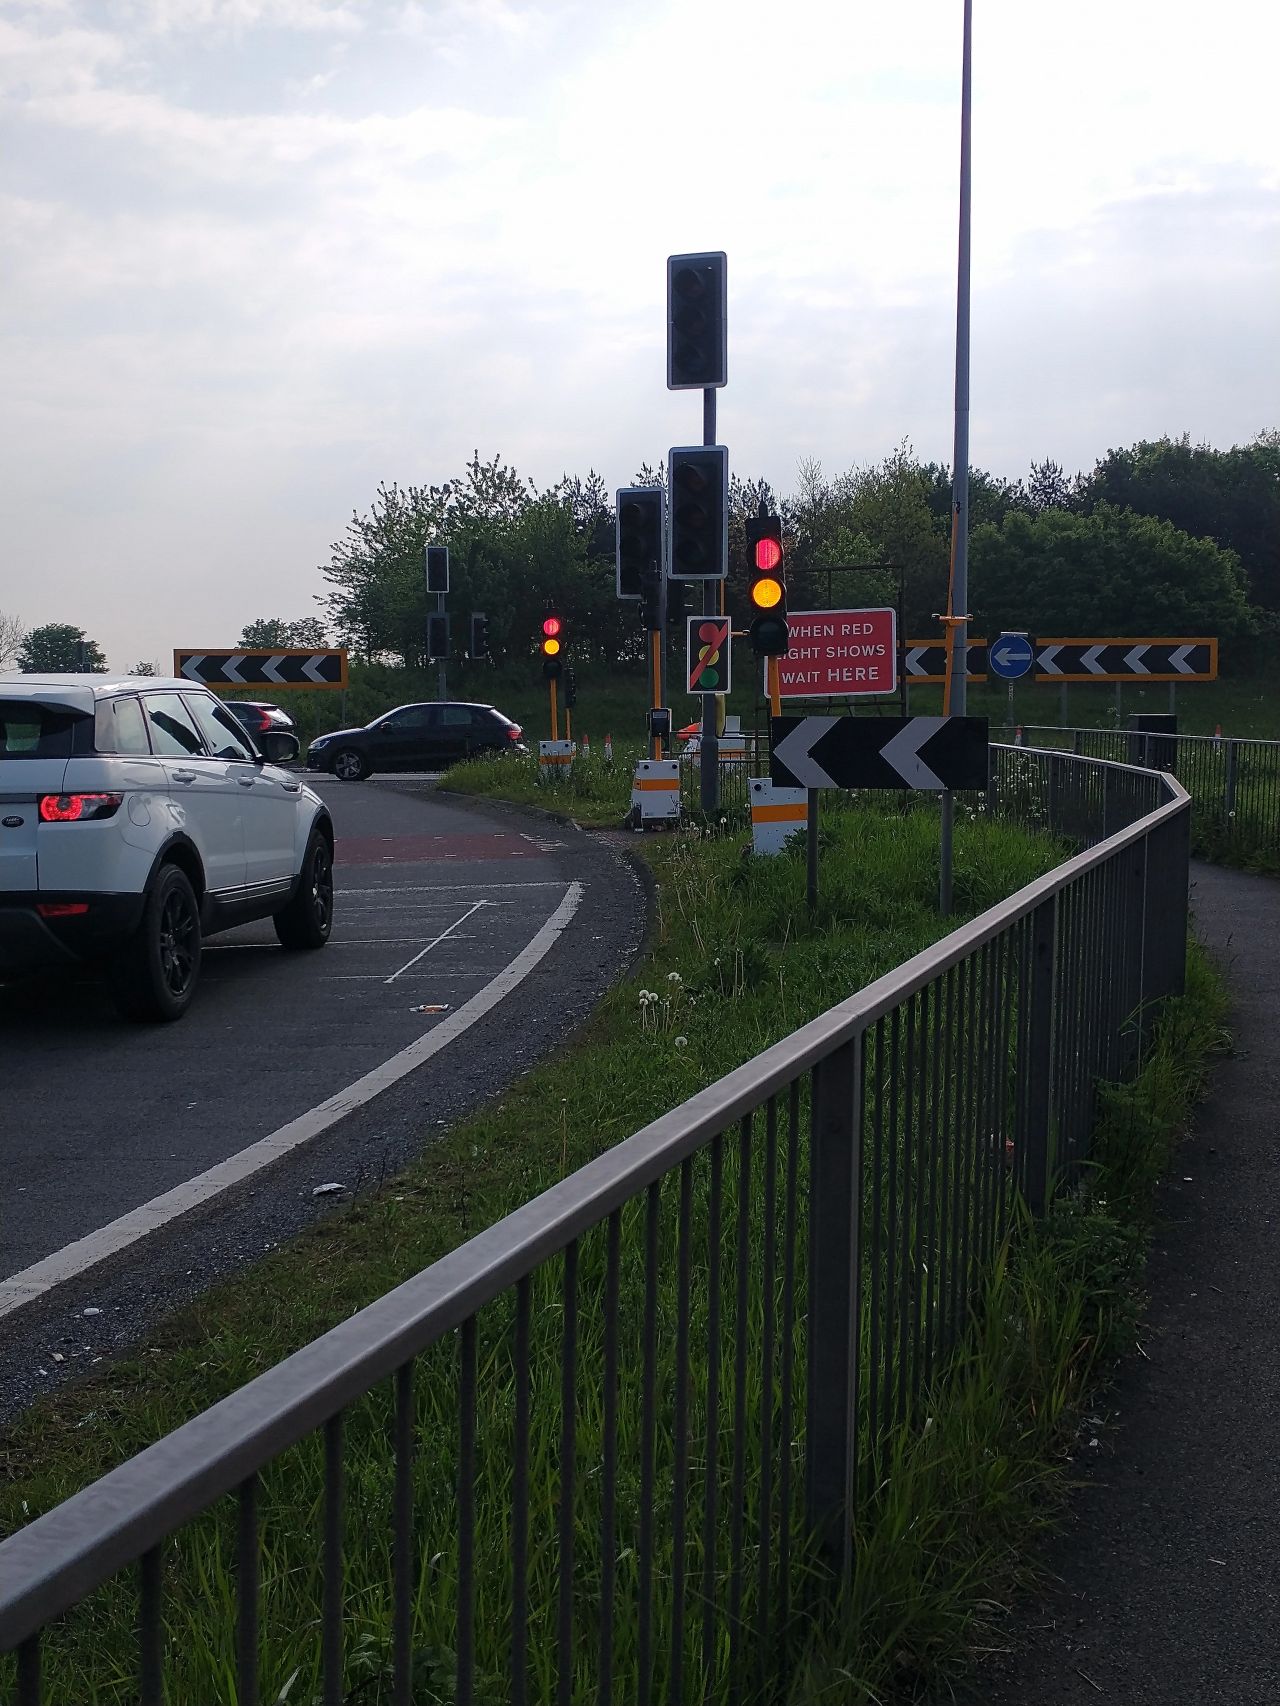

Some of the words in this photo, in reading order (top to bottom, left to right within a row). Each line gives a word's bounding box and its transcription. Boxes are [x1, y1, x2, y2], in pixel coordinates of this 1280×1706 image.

[788, 625, 835, 638] WHEN
[841, 623, 874, 636] RED
[826, 644, 886, 658] SHOWS
[781, 671, 821, 684] WAIT
[827, 666, 879, 682] HERE
